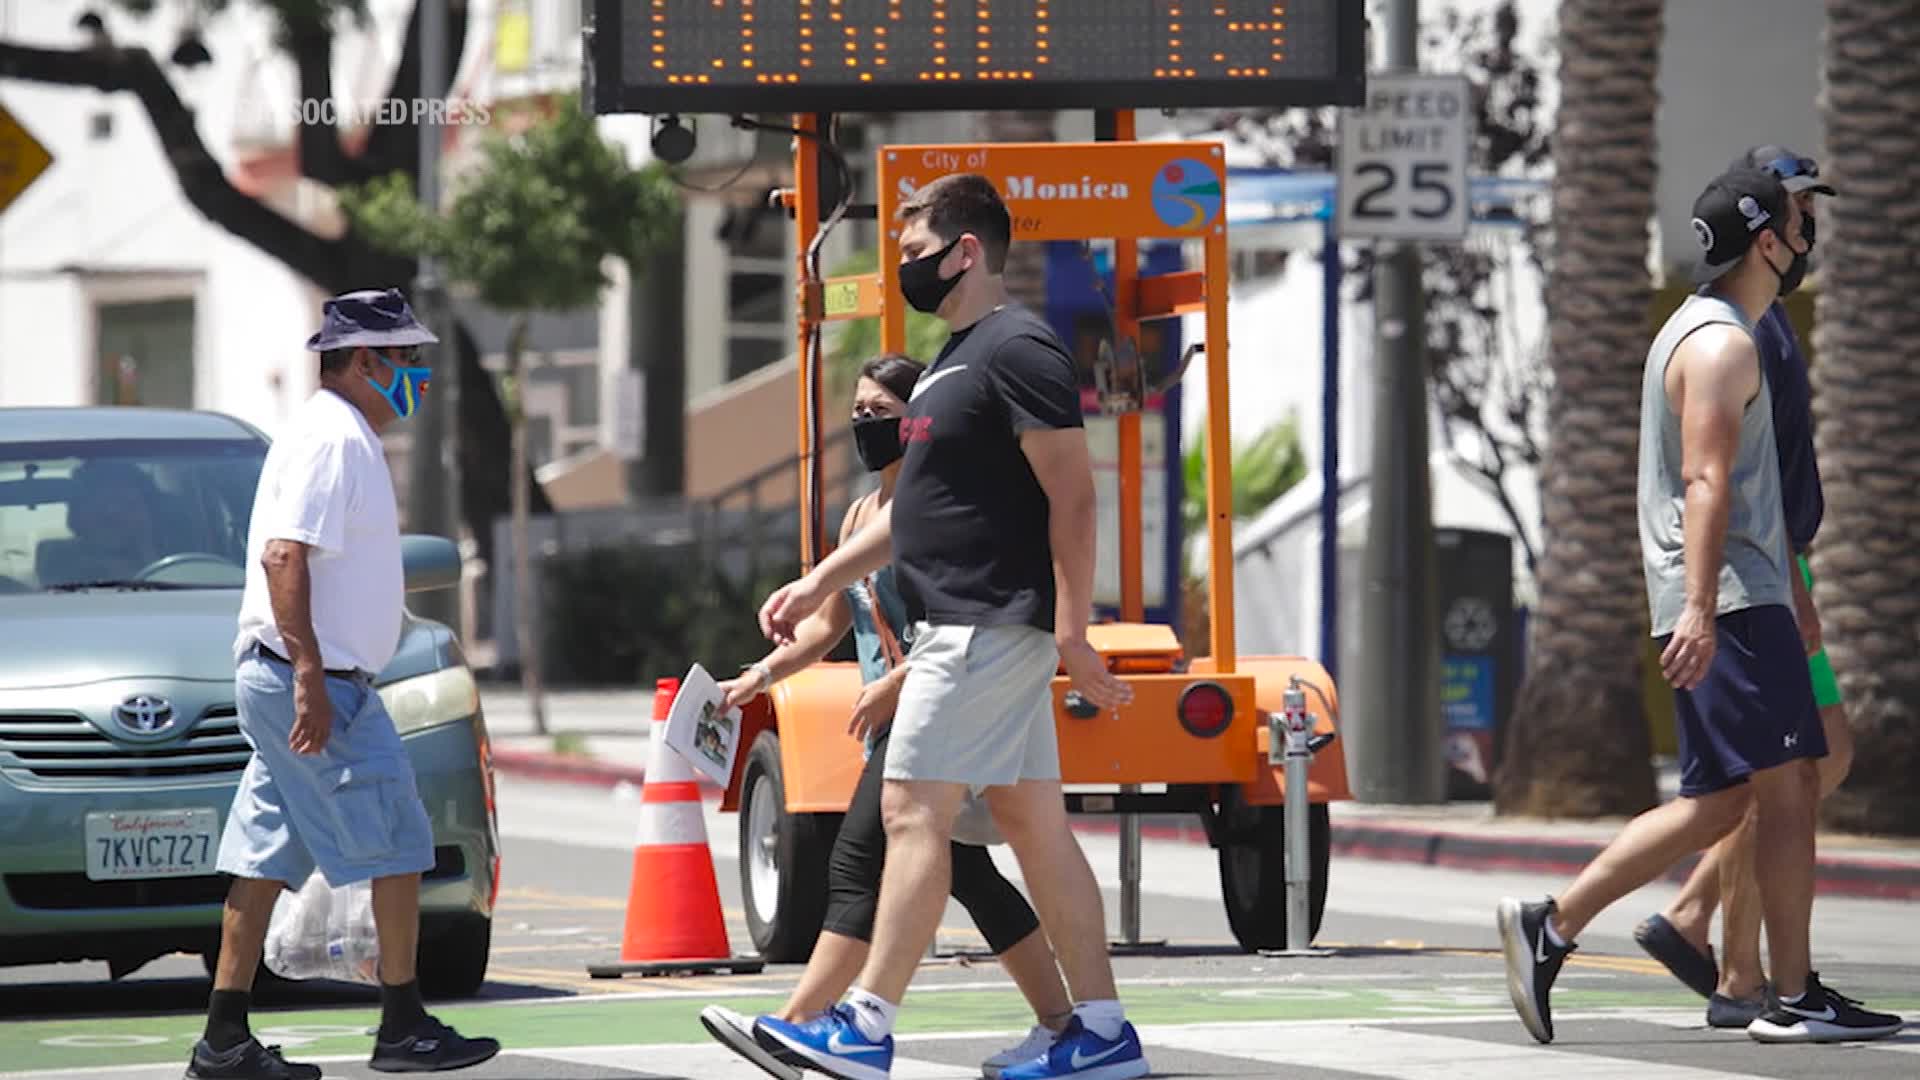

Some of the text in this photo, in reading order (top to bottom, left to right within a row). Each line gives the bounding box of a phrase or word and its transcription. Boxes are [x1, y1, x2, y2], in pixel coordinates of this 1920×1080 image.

[651, 0, 1284, 83] COVID 19
[1352, 88, 1460, 119] PEED
[1360, 127, 1443, 150] LIMIT
[922, 150, 987, 170] City of
[1005, 176, 1129, 200] Monica
[1353, 161, 1456, 221] 25
[97, 834, 210, 868] 7KVC727
